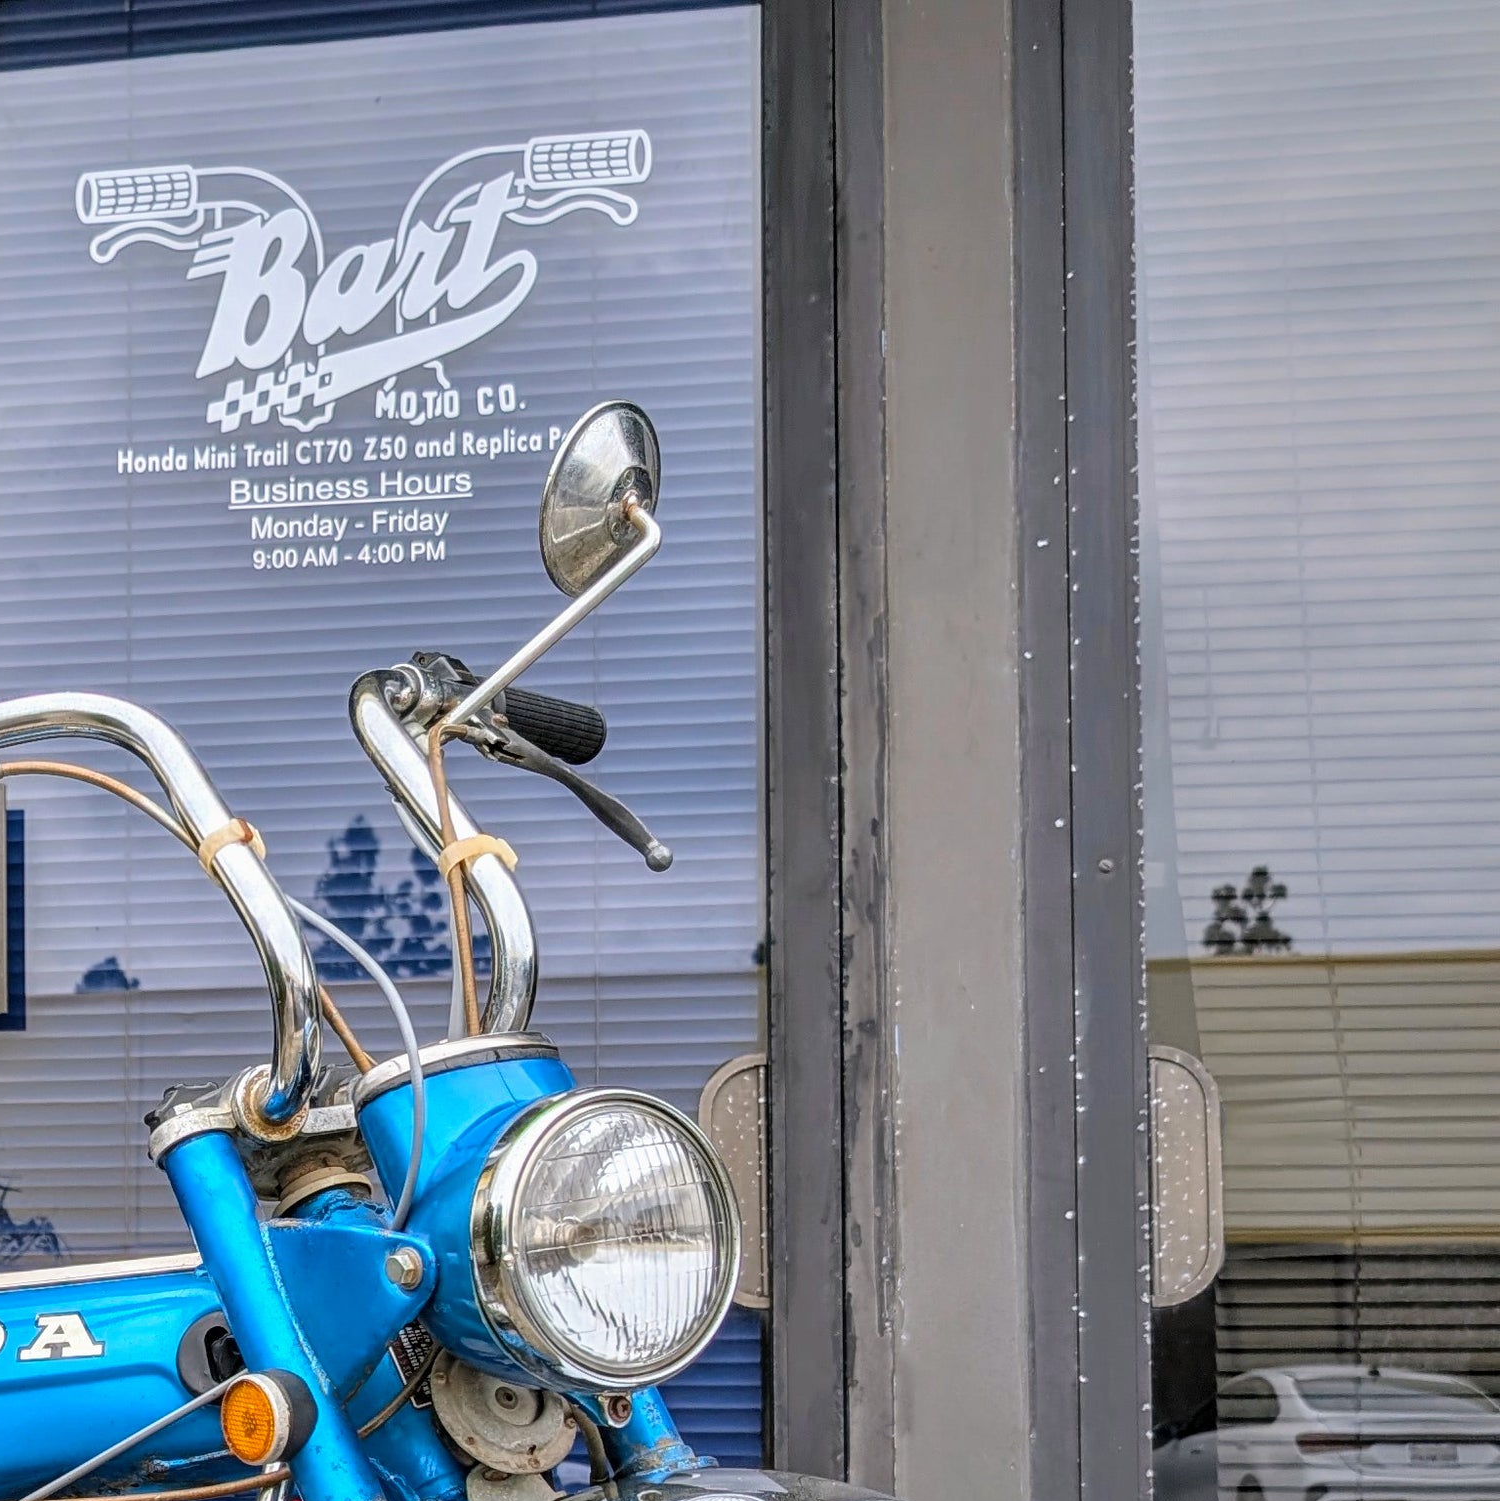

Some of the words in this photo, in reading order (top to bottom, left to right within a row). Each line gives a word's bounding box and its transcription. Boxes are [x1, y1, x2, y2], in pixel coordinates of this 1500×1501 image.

[187, 171, 537, 382] Bart
[476, 383, 527, 416] CO.
[117, 446, 188, 474] Honda
[194, 444, 236, 470] Mini
[243, 439, 289, 468] Trail
[295, 438, 353, 465] CT70
[363, 436, 407, 462] Z50
[414, 431, 455, 458] and
[462, 427, 542, 460] Replica
[230, 475, 368, 505] Business
[380, 470, 472, 497] Hours
[252, 512, 348, 541] Monday
[372, 509, 449, 536] Friday
[253, 549, 298, 570] 9:00
[301, 547, 338, 568] AM
[357, 543, 405, 564] 4:00
[410, 541, 446, 561] PM
